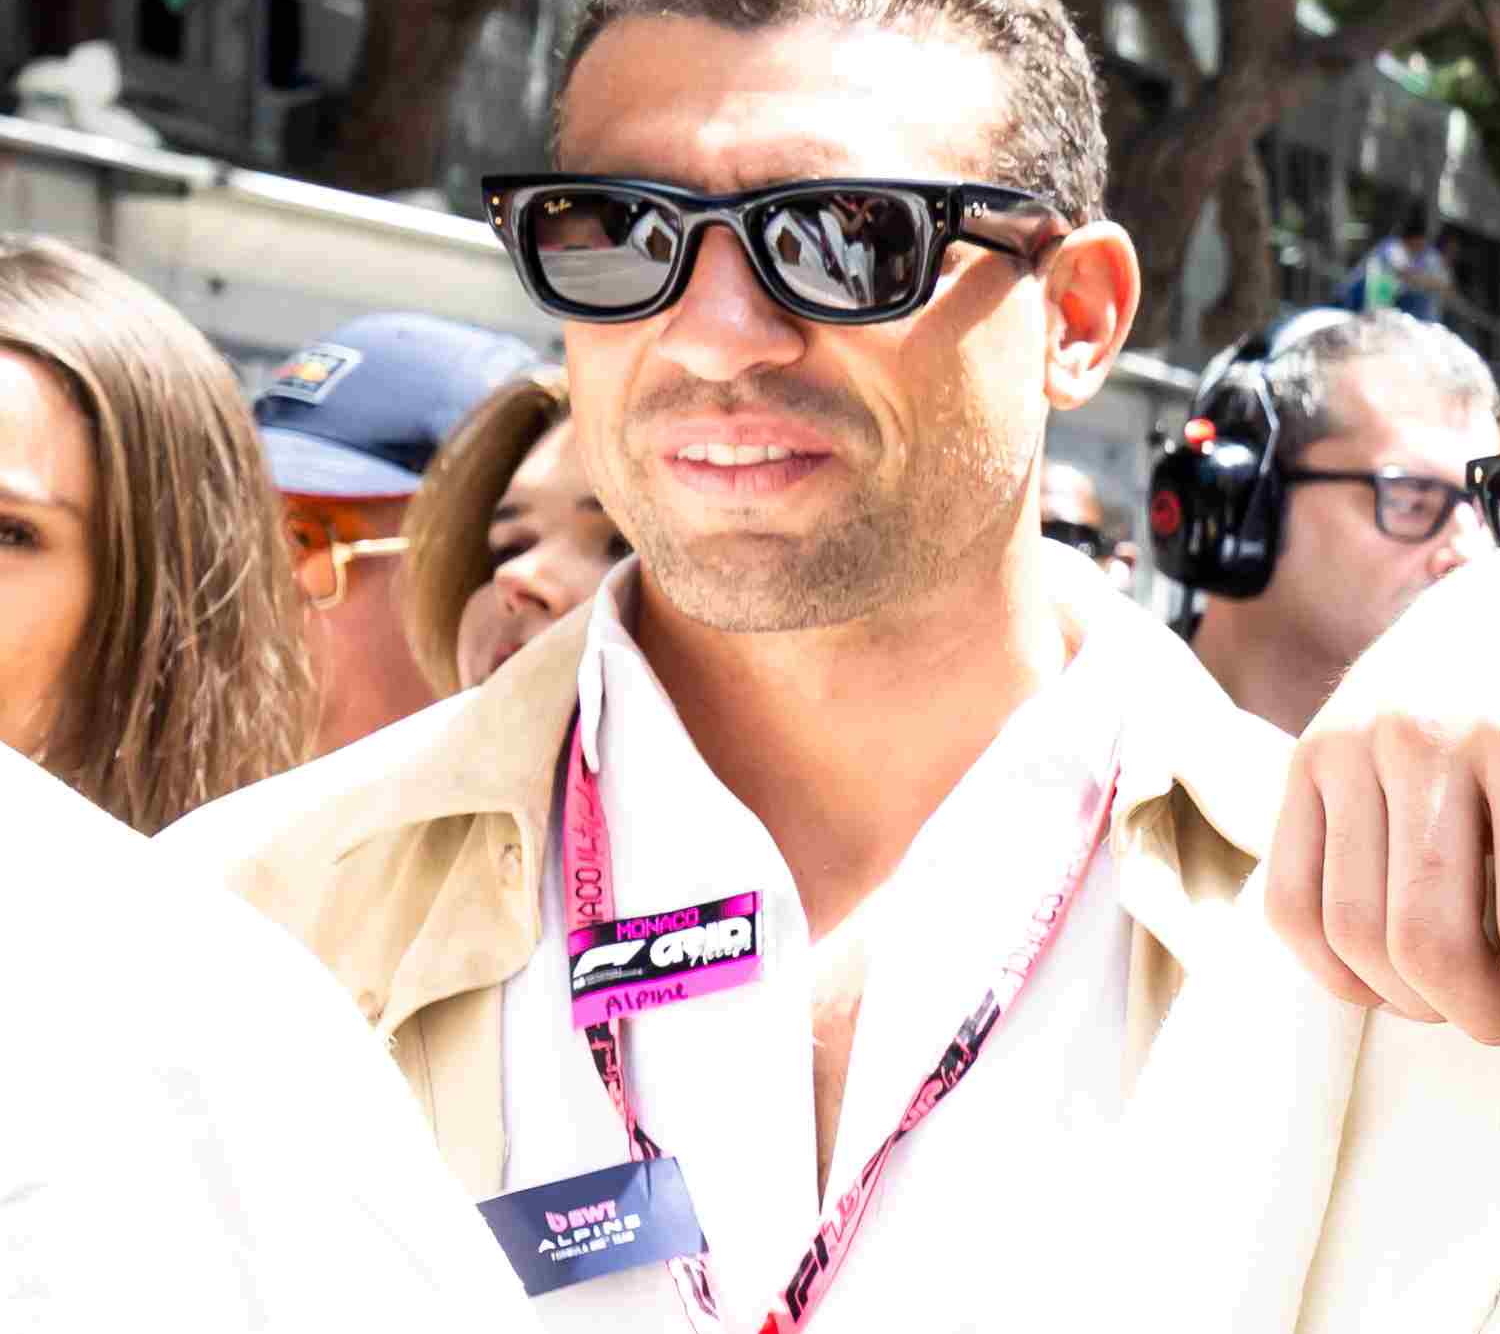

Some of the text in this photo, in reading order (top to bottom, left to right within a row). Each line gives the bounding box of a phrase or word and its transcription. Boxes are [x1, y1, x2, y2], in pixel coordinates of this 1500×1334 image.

[616, 906, 699, 942] MONACO
[605, 983, 690, 1017] Alpine
[537, 1214, 641, 1254] ALPINE
